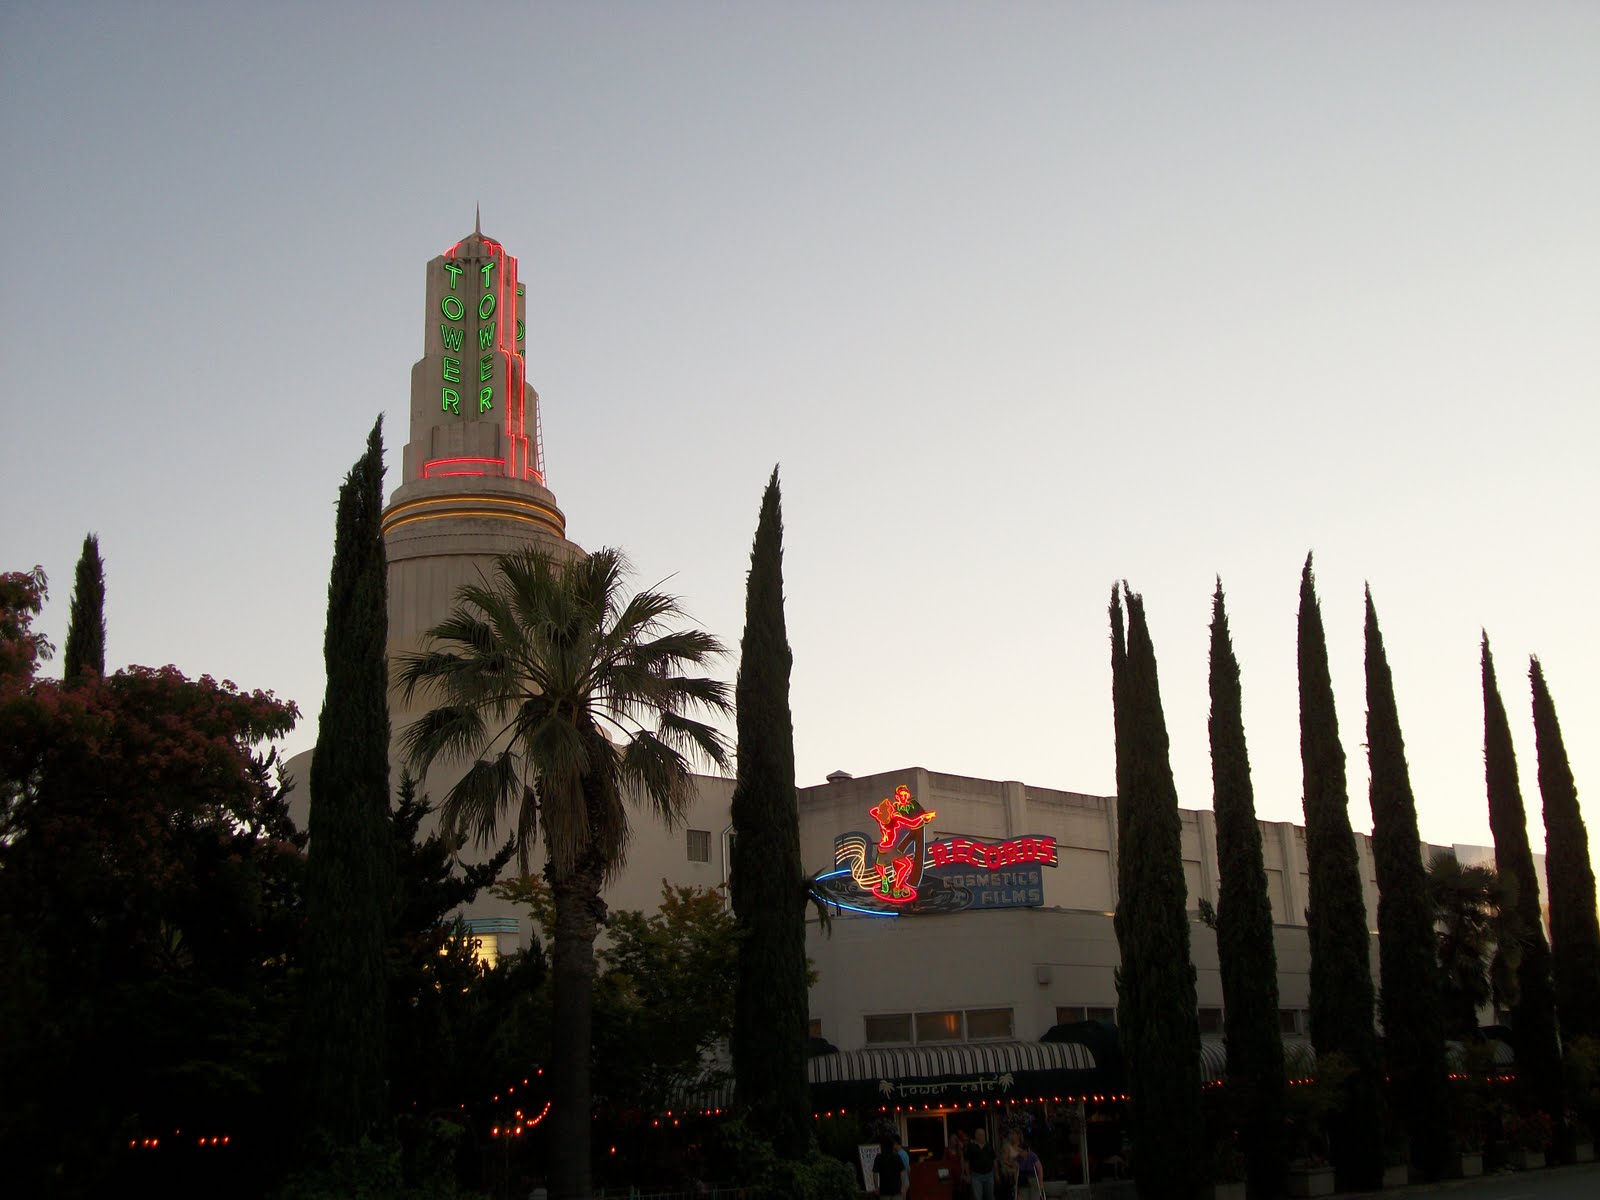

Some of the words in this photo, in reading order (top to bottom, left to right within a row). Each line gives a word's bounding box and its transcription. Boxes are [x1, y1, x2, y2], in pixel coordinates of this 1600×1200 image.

[441, 263, 465, 415] TOWER
[478, 262, 497, 414] TOWER
[931, 838, 1055, 870] RECORDS
[943, 871, 1039, 888] COSMETICS
[982, 889, 1040, 905] FILMS
